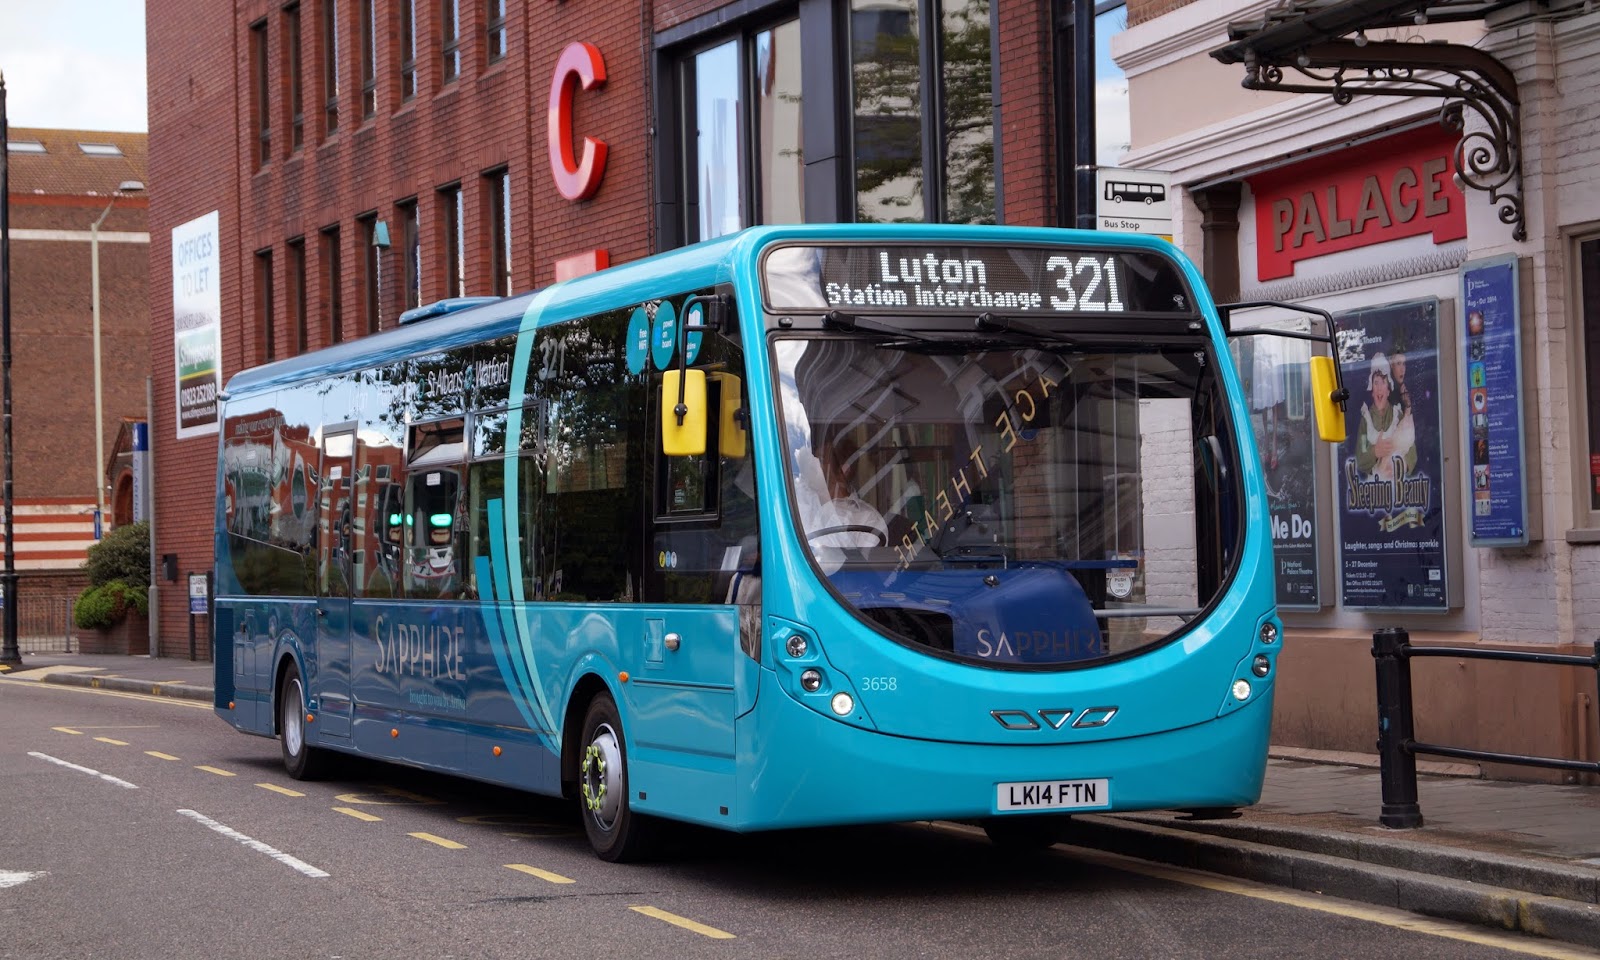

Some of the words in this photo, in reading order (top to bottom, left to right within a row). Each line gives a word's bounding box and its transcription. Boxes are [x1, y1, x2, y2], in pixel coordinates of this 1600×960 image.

[1272, 157, 1449, 252] PALACE
[1104, 219, 1119, 228] Bus
[1120, 220, 1140, 231] Stop
[178, 232, 213, 267] OFFICES
[181, 272, 192, 298] TO
[194, 266, 209, 294] LET
[879, 251, 987, 285] Luton
[1046, 256, 1124, 311] 321
[825, 283, 908, 306] Station
[915, 287, 1042, 310] Interchange
[538, 335, 567, 381] 321
[1345, 459, 1392, 514] Sleeping
[1392, 455, 1430, 512] Beauty
[1270, 514, 1289, 539] Me
[1291, 513, 1312, 539] Do
[1344, 541, 1367, 551] Laughter,
[1368, 542, 1382, 550] songs
[1384, 540, 1394, 549] and
[1395, 540, 1418, 549] Christmas
[1419, 539, 1439, 549] sparkle
[1357, 560, 1378, 568] December
[375, 614, 466, 680] SAPPHIRE
[861, 677, 898, 691] 3658
[1010, 783, 1053, 806] LK14
[1058, 783, 1096, 804] FTN
